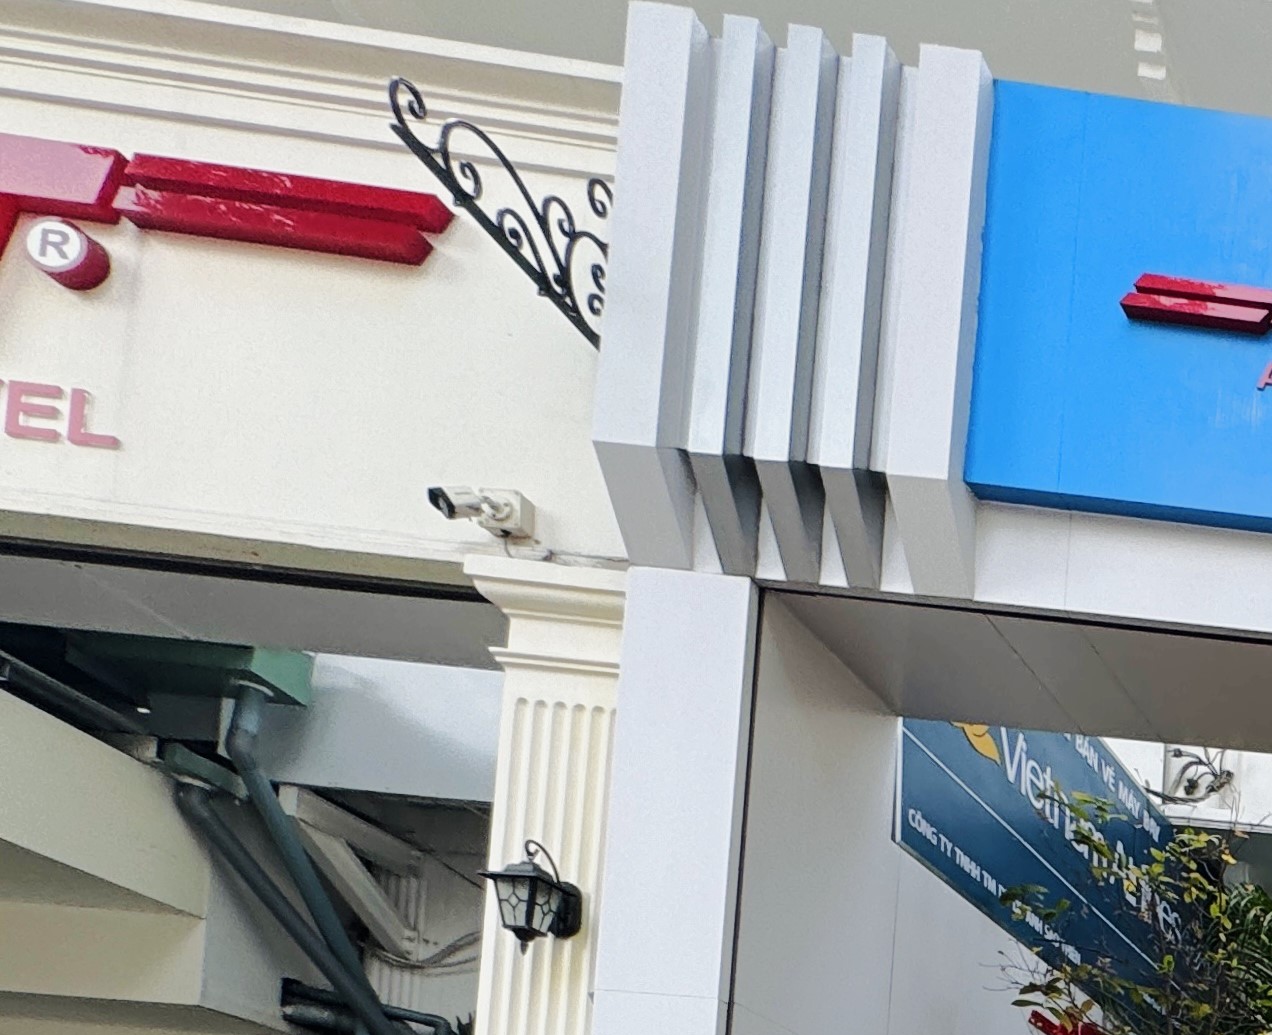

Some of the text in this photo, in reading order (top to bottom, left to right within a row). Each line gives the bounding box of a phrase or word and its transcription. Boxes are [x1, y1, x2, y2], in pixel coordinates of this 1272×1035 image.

[0, 378, 121, 450] EL
[908, 807, 938, 847] CÔNG
[938, 833, 955, 858] TY
